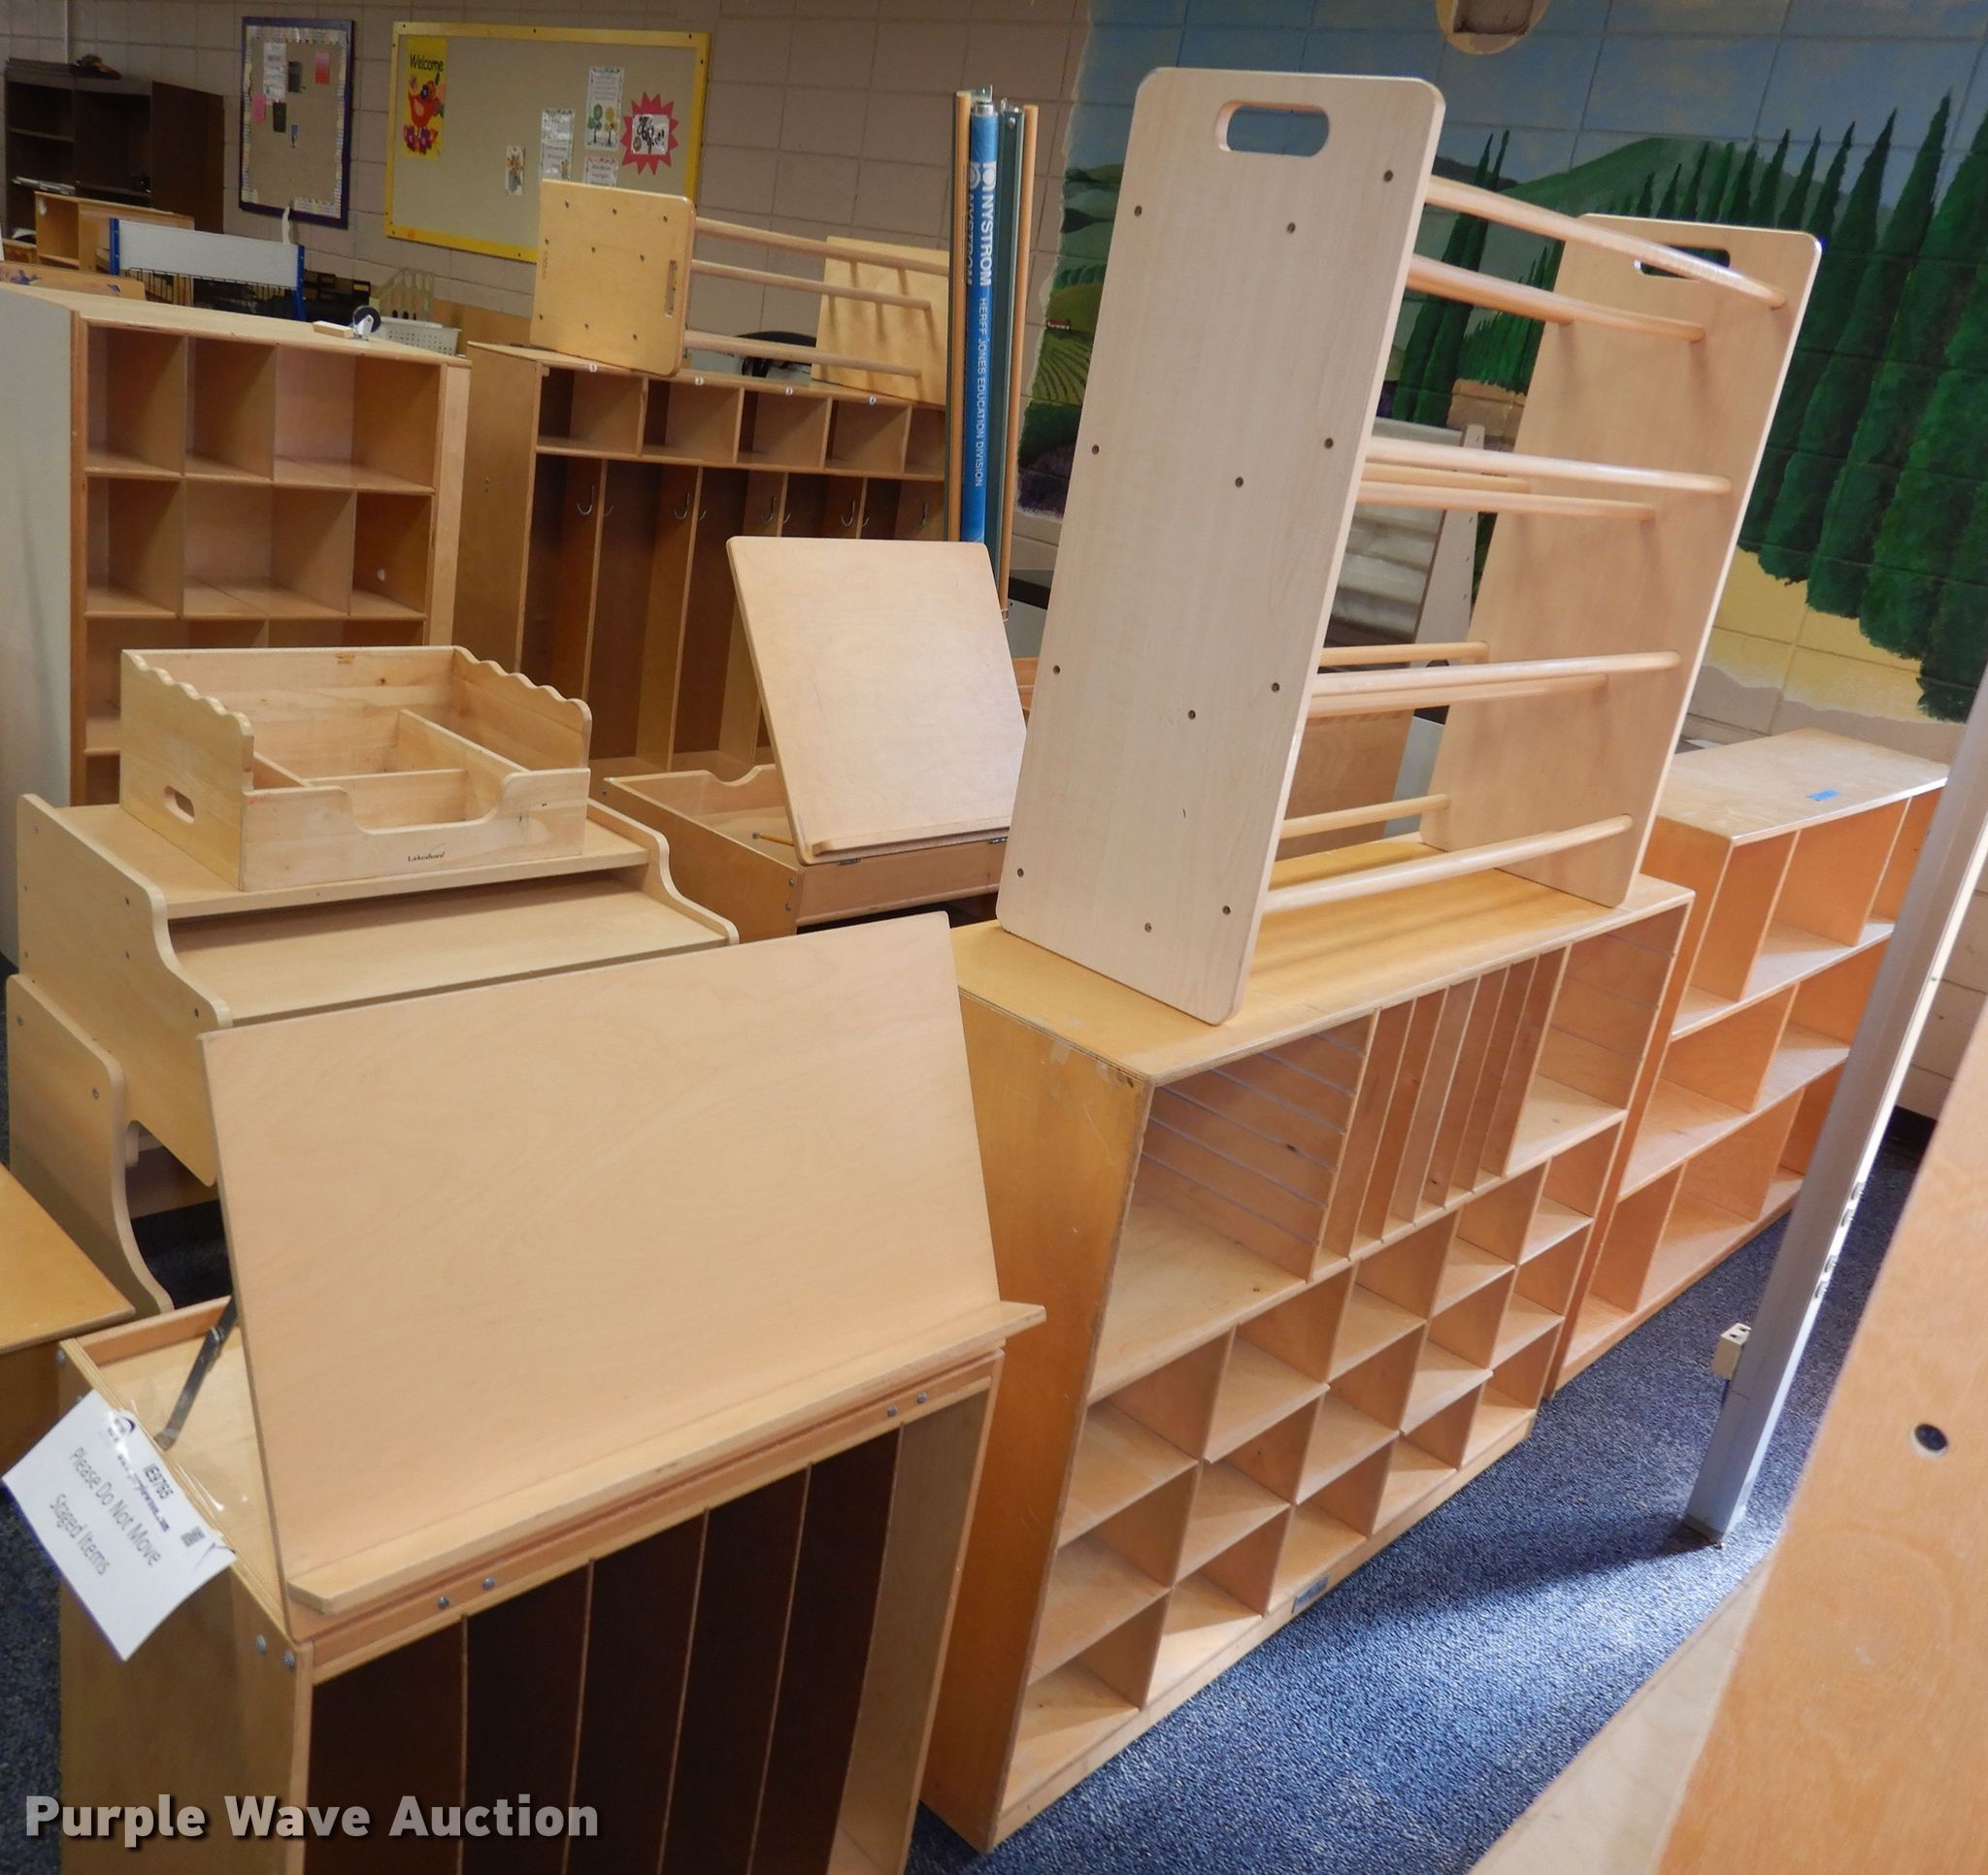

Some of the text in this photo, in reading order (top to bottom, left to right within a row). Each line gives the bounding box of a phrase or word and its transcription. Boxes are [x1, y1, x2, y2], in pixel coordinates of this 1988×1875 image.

[410, 53, 444, 72] Welcome
[979, 194, 994, 286] NYSTROM
[975, 297, 988, 487] HERFF JONES EDUCATION DIVISION
[50, 1494, 111, 1575] Staged Items
[68, 1446, 162, 1566] Please Do Not Move
